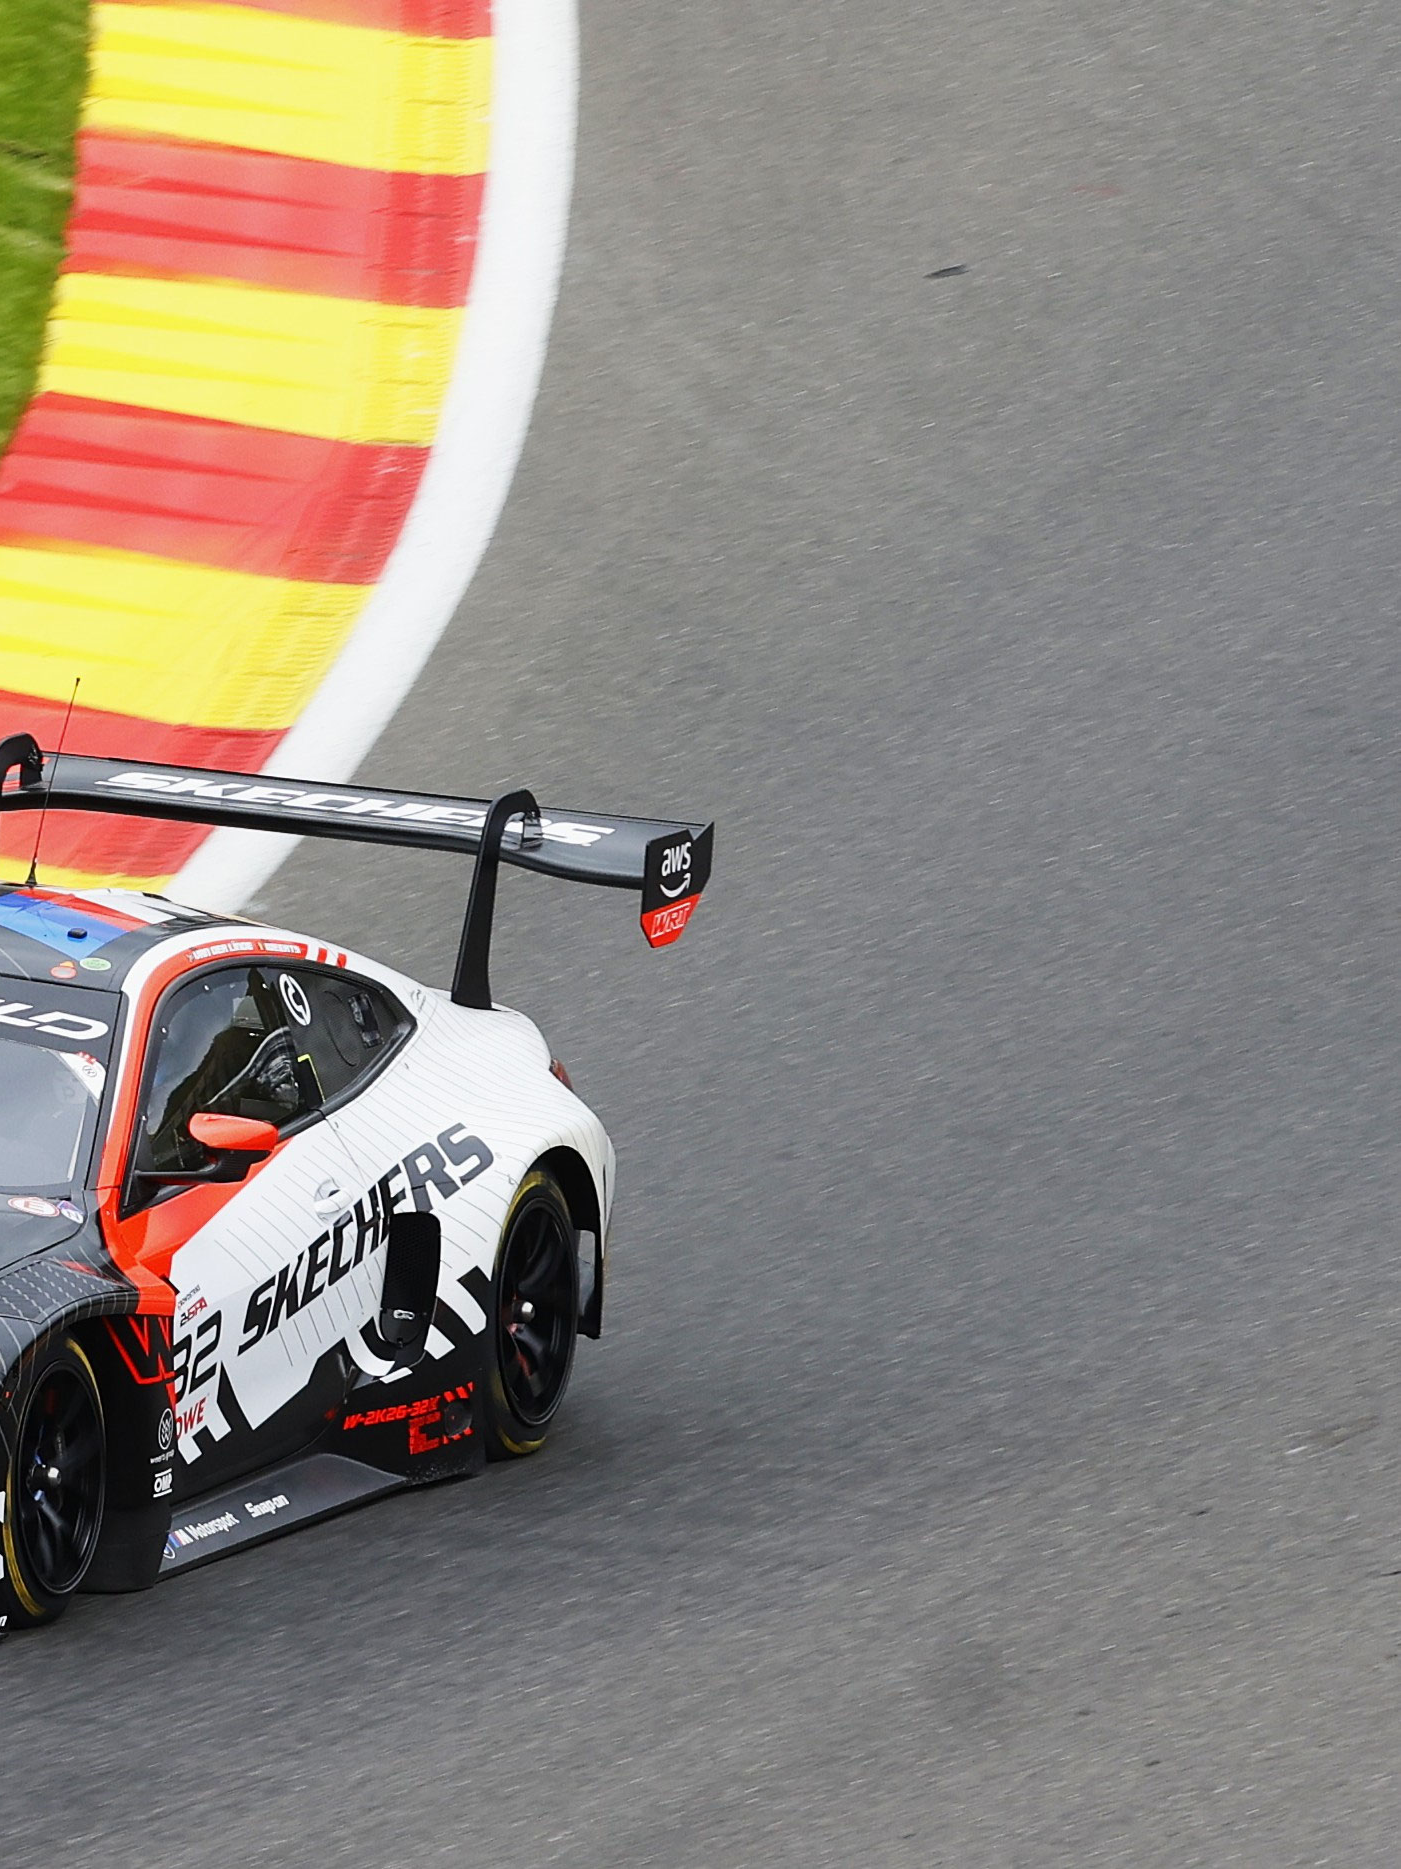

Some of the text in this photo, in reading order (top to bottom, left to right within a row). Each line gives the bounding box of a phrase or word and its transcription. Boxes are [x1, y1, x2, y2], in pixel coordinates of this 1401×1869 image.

[94, 771, 616, 846] SKECHES
[661, 841, 692, 877] aws
[650, 902, 691, 939] WRT
[237, 1122, 495, 1356] SKECHERS
[154, 1472, 173, 1493] OMP
[184, 1511, 240, 1541] Motorsport
